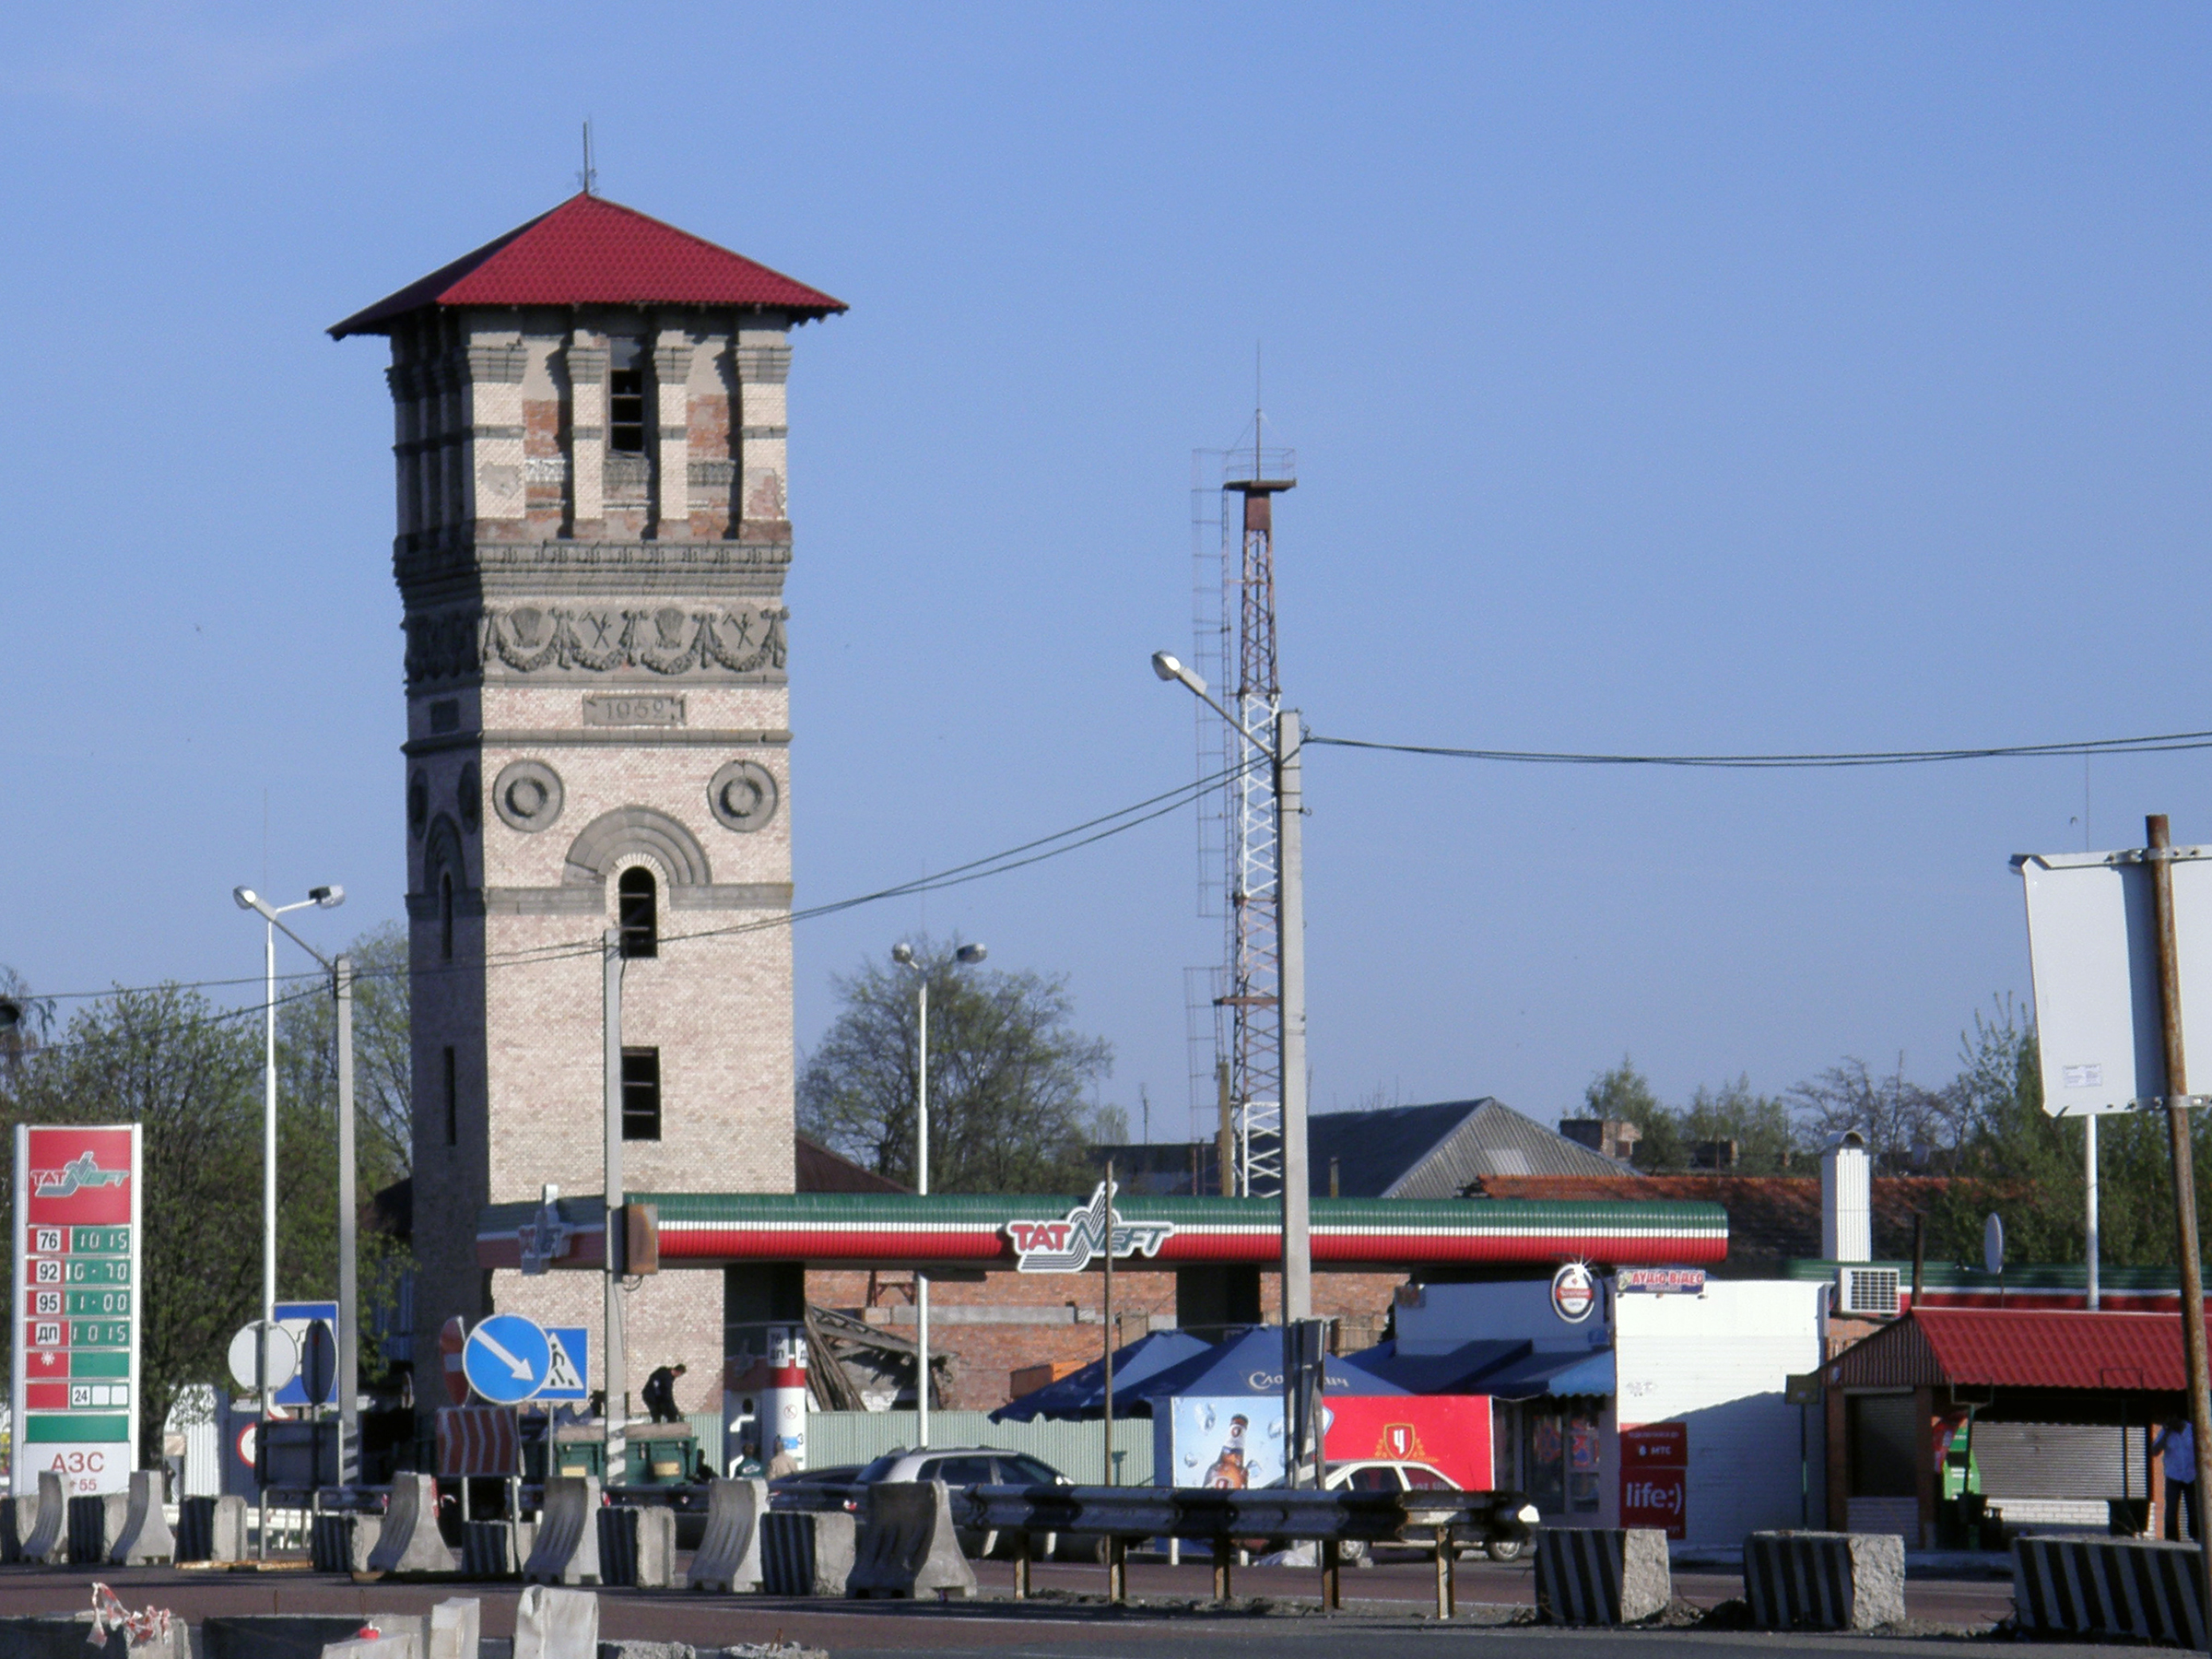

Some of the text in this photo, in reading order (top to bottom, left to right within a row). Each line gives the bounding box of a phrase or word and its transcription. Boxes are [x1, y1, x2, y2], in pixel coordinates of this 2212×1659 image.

[40, 1232, 58, 1249] 76
[40, 1264, 58, 1280] 92
[39, 1295, 58, 1312] 95
[74, 1389, 88, 1403] 24
[51, 1452, 105, 1474] АЗС
